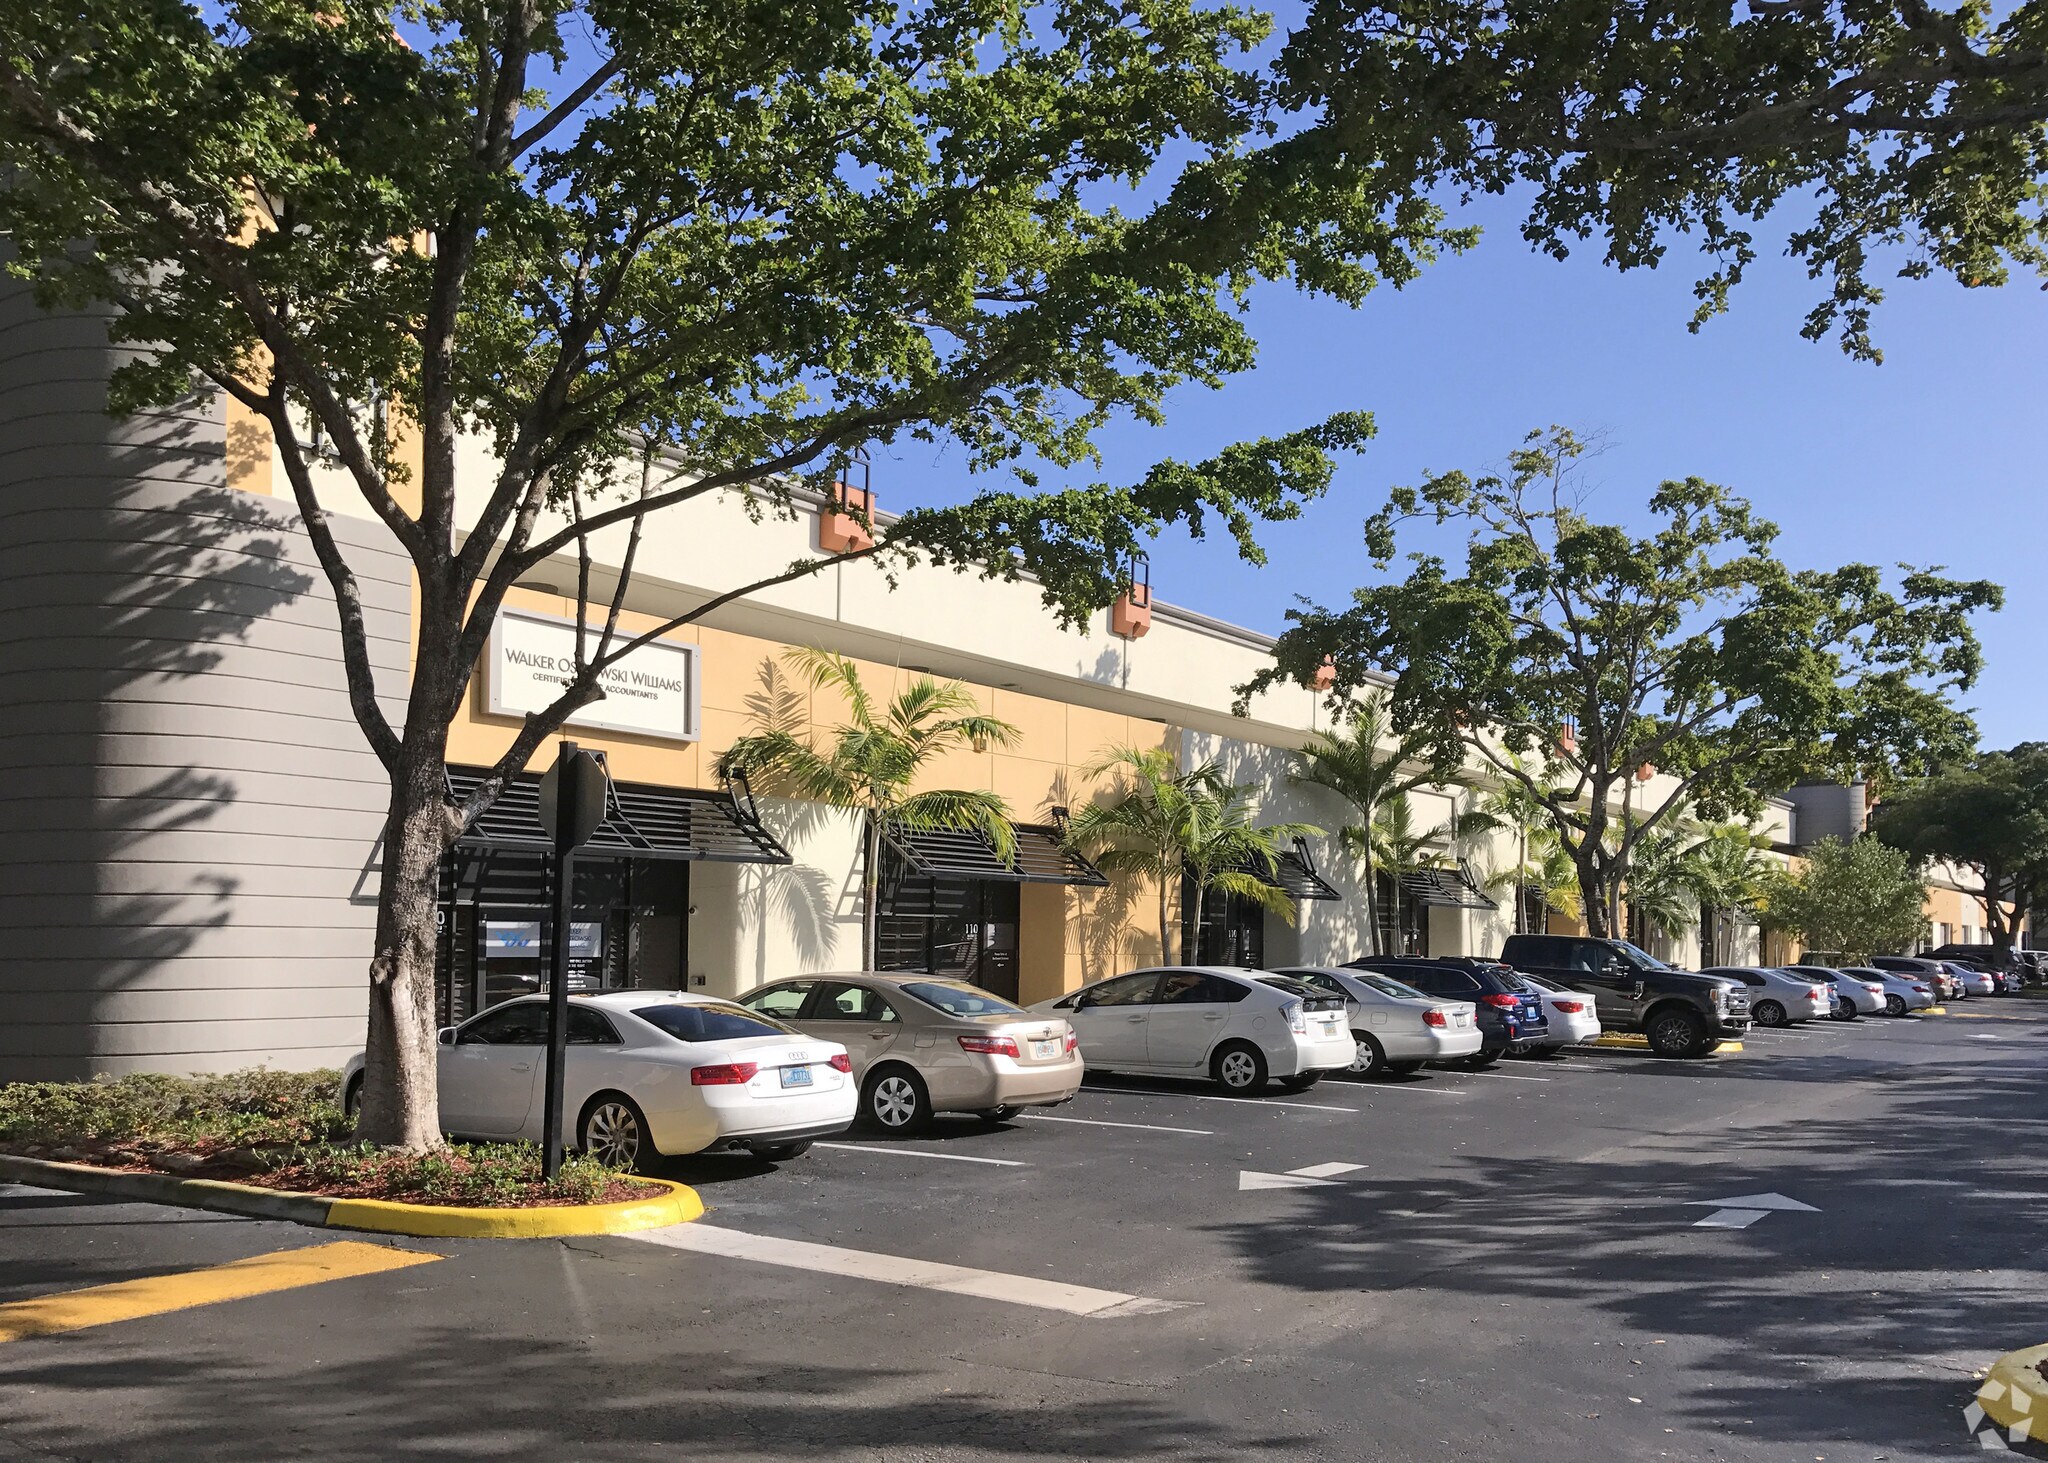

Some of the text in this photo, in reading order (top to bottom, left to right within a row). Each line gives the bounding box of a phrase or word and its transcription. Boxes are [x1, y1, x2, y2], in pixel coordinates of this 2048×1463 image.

[505, 648, 682, 693] WALKER OSWSKI WILLIAMS
[605, 684, 659, 700] ACCOUNTANTS
[965, 923, 979, 934] 110
